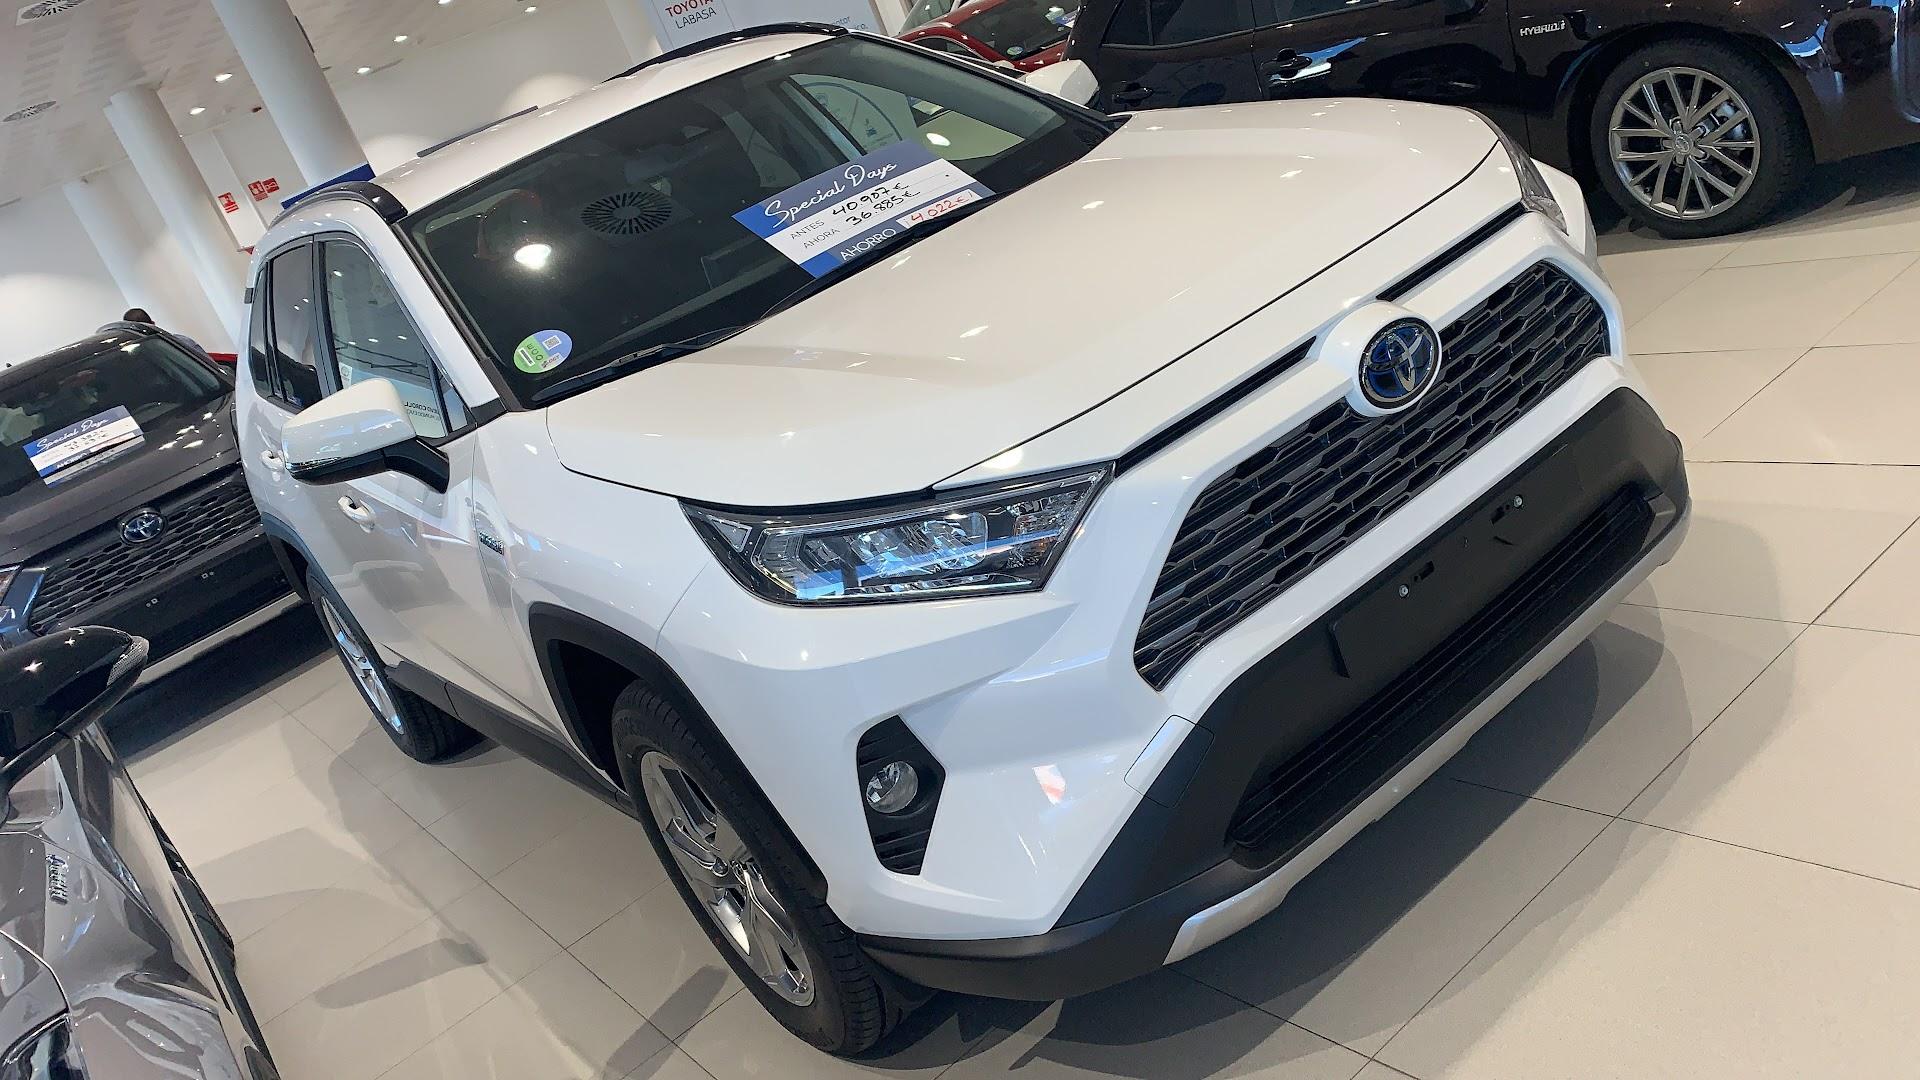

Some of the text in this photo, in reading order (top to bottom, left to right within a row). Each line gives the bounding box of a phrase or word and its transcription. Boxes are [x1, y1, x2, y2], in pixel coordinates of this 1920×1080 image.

[675, 7, 717, 29] LABASA
[765, 163, 897, 228] Special Days
[790, 219, 825, 240] ANTES
[803, 228, 840, 249] AHORA
[840, 228, 897, 261] AHORRO
